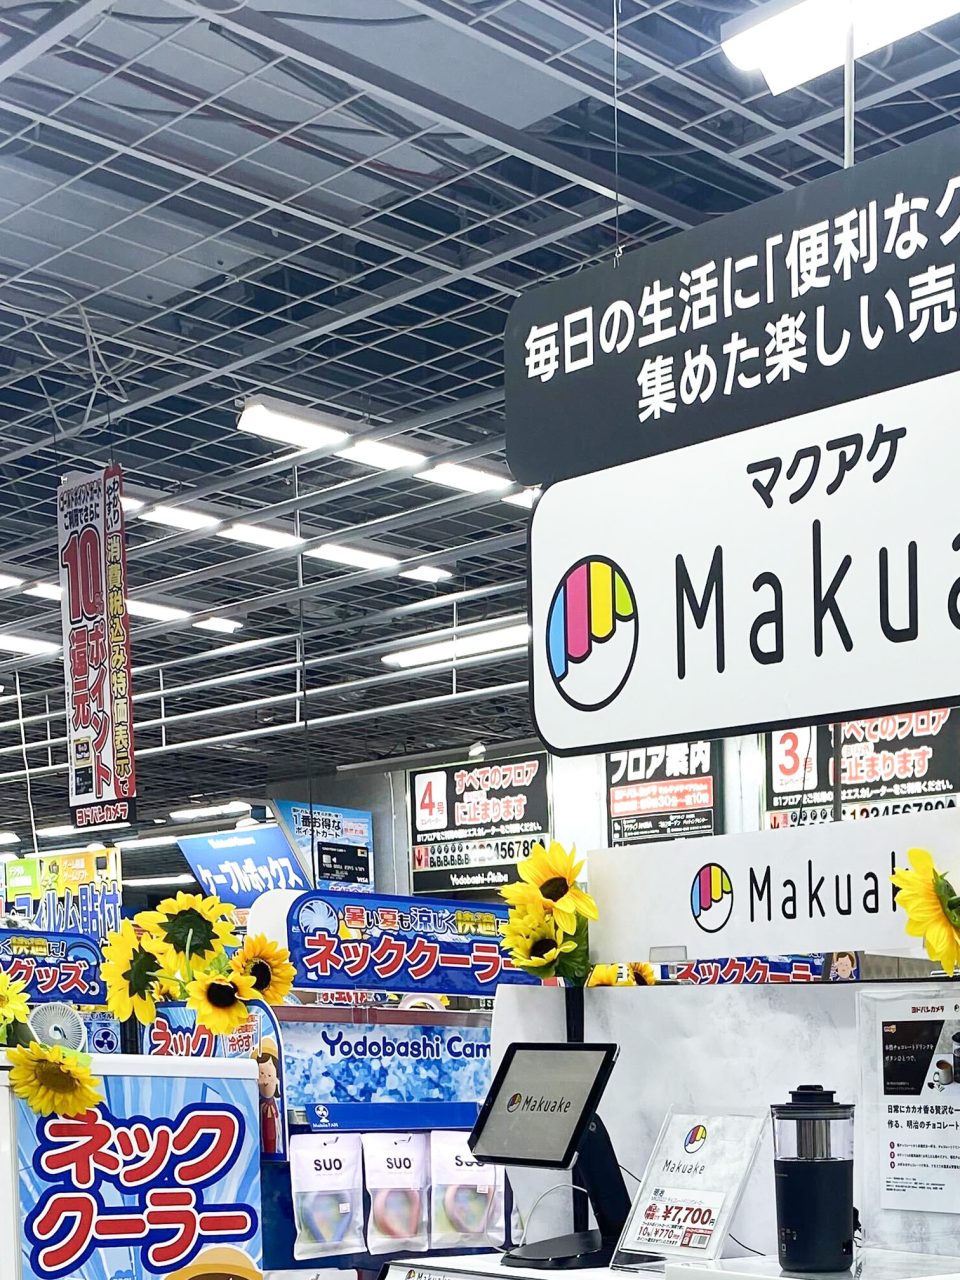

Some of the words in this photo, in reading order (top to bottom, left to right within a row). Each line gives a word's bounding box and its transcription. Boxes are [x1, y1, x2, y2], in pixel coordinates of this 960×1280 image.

[746, 423, 907, 509] マクアケ
[610, 740, 711, 784] フロア案内
[454, 760, 539, 794] すべてのフロア
[75, 801, 130, 827] ヨドバシカメラ
[454, 794, 527, 825] に止まります
[911, 1005, 945, 1014] ヨドバシカメラ
[321, 1031, 441, 1059] Yodobashi
[521, 1095, 571, 1113] Makuake
[44, 1108, 239, 1187] ネック
[313, 1157, 343, 1172] SUO
[385, 1156, 413, 1171] SUO
[662, 1159, 706, 1175] Makuake
[36, 1191, 250, 1271] クーラー
